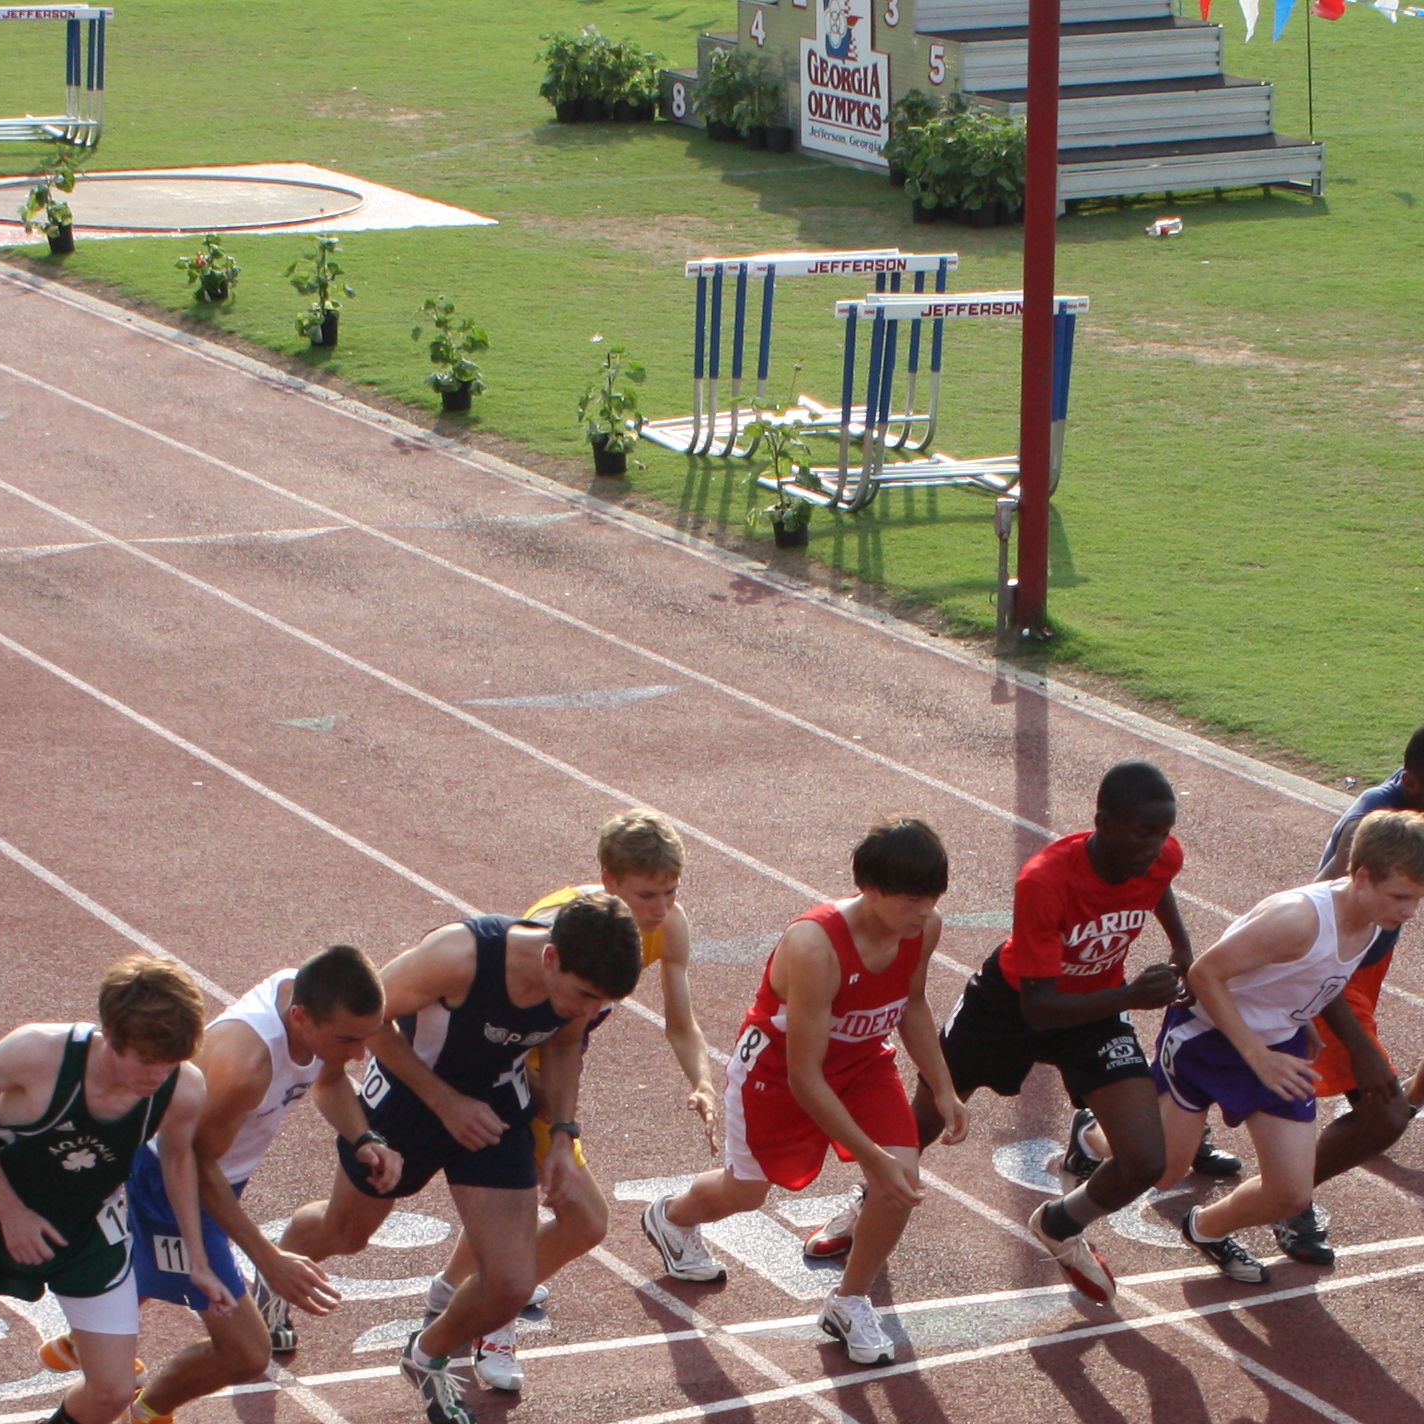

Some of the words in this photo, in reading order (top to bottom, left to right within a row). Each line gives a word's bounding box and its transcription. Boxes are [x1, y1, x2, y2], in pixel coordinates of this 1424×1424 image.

[2, 10, 76, 19] JEFFERSON
[750, 10, 766, 47] 4
[807, 49, 882, 99] GEORGIA
[929, 44, 947, 85] 5
[672, 82, 686, 118] 8
[807, 89, 882, 131] OLYMPICS
[809, 125, 848, 146] Jefferson,
[808, 259, 906, 274] JEFFERSON
[921, 302, 1024, 318] JEFFERSON
[740, 1027, 762, 1063] 8
[364, 1064, 384, 1100] 10
[161, 1238, 185, 1271] 11
